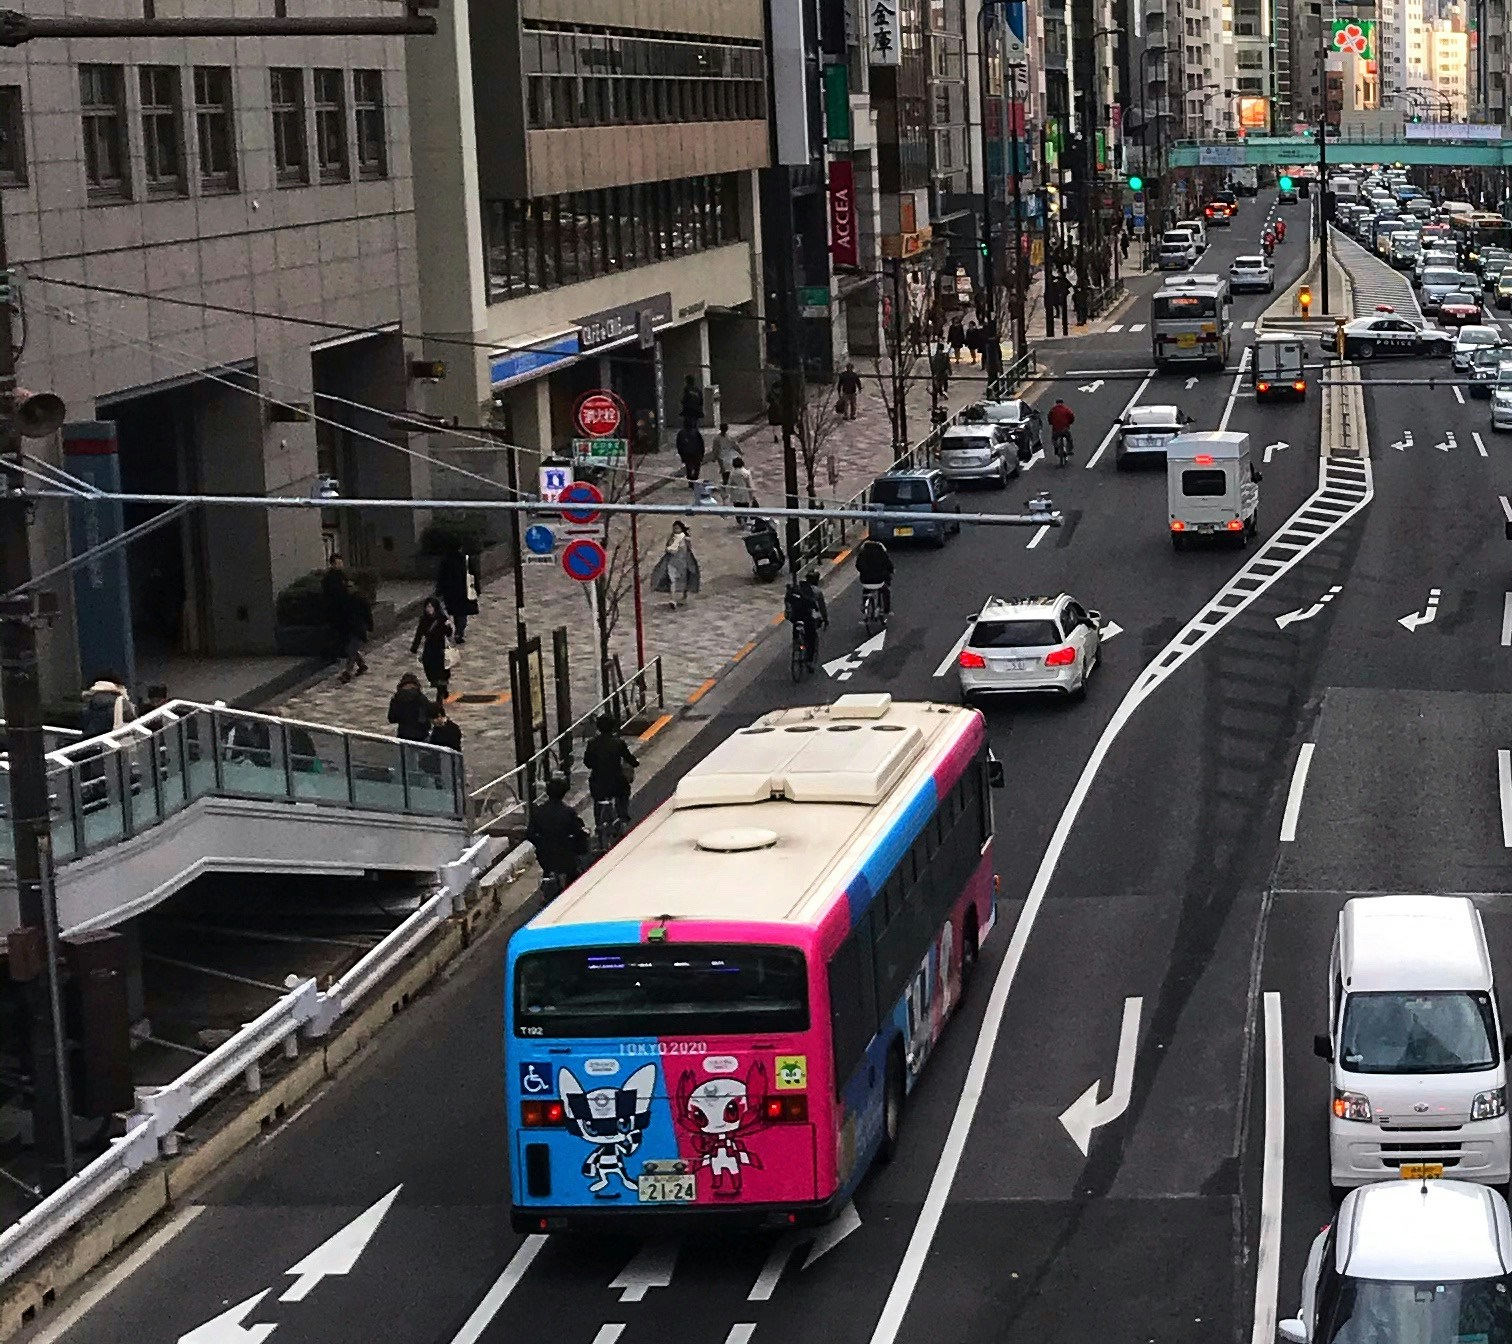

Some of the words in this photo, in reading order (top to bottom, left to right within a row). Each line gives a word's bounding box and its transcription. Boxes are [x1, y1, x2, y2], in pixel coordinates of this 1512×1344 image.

[836, 188, 850, 249] ACCEA
[1376, 339, 1412, 347] POLICE
[583, 408, 616, 424] 消火栓
[619, 1043, 666, 1056] TOKYO
[669, 1041, 708, 1055] 2020
[647, 1183, 694, 1199] 21-24
